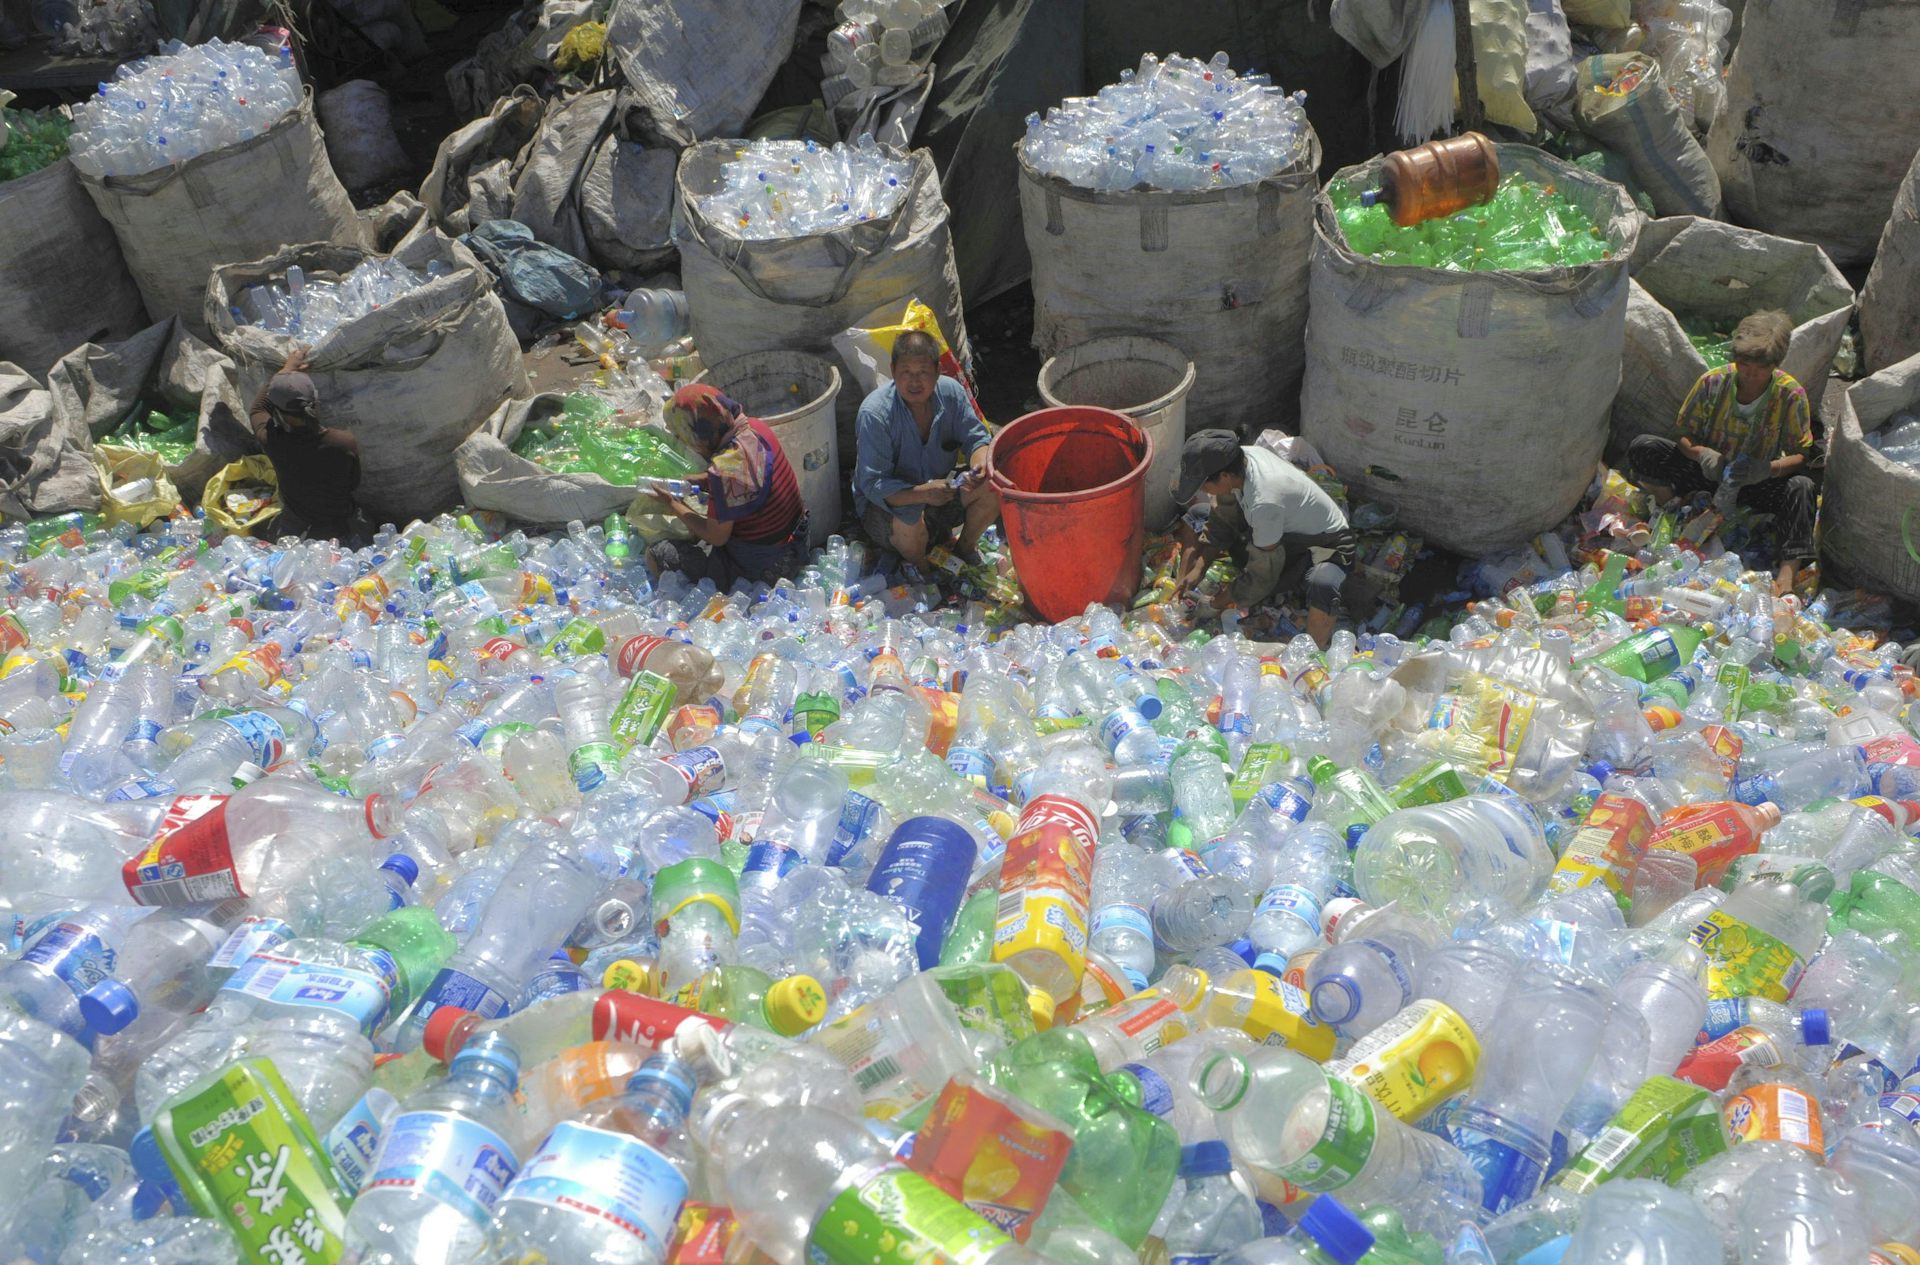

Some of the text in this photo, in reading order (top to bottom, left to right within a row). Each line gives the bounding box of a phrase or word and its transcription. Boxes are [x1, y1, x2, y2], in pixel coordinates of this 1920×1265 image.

[1395, 407, 1448, 433] 昆仑
[1364, 1070, 1405, 1119] 汁饮品
